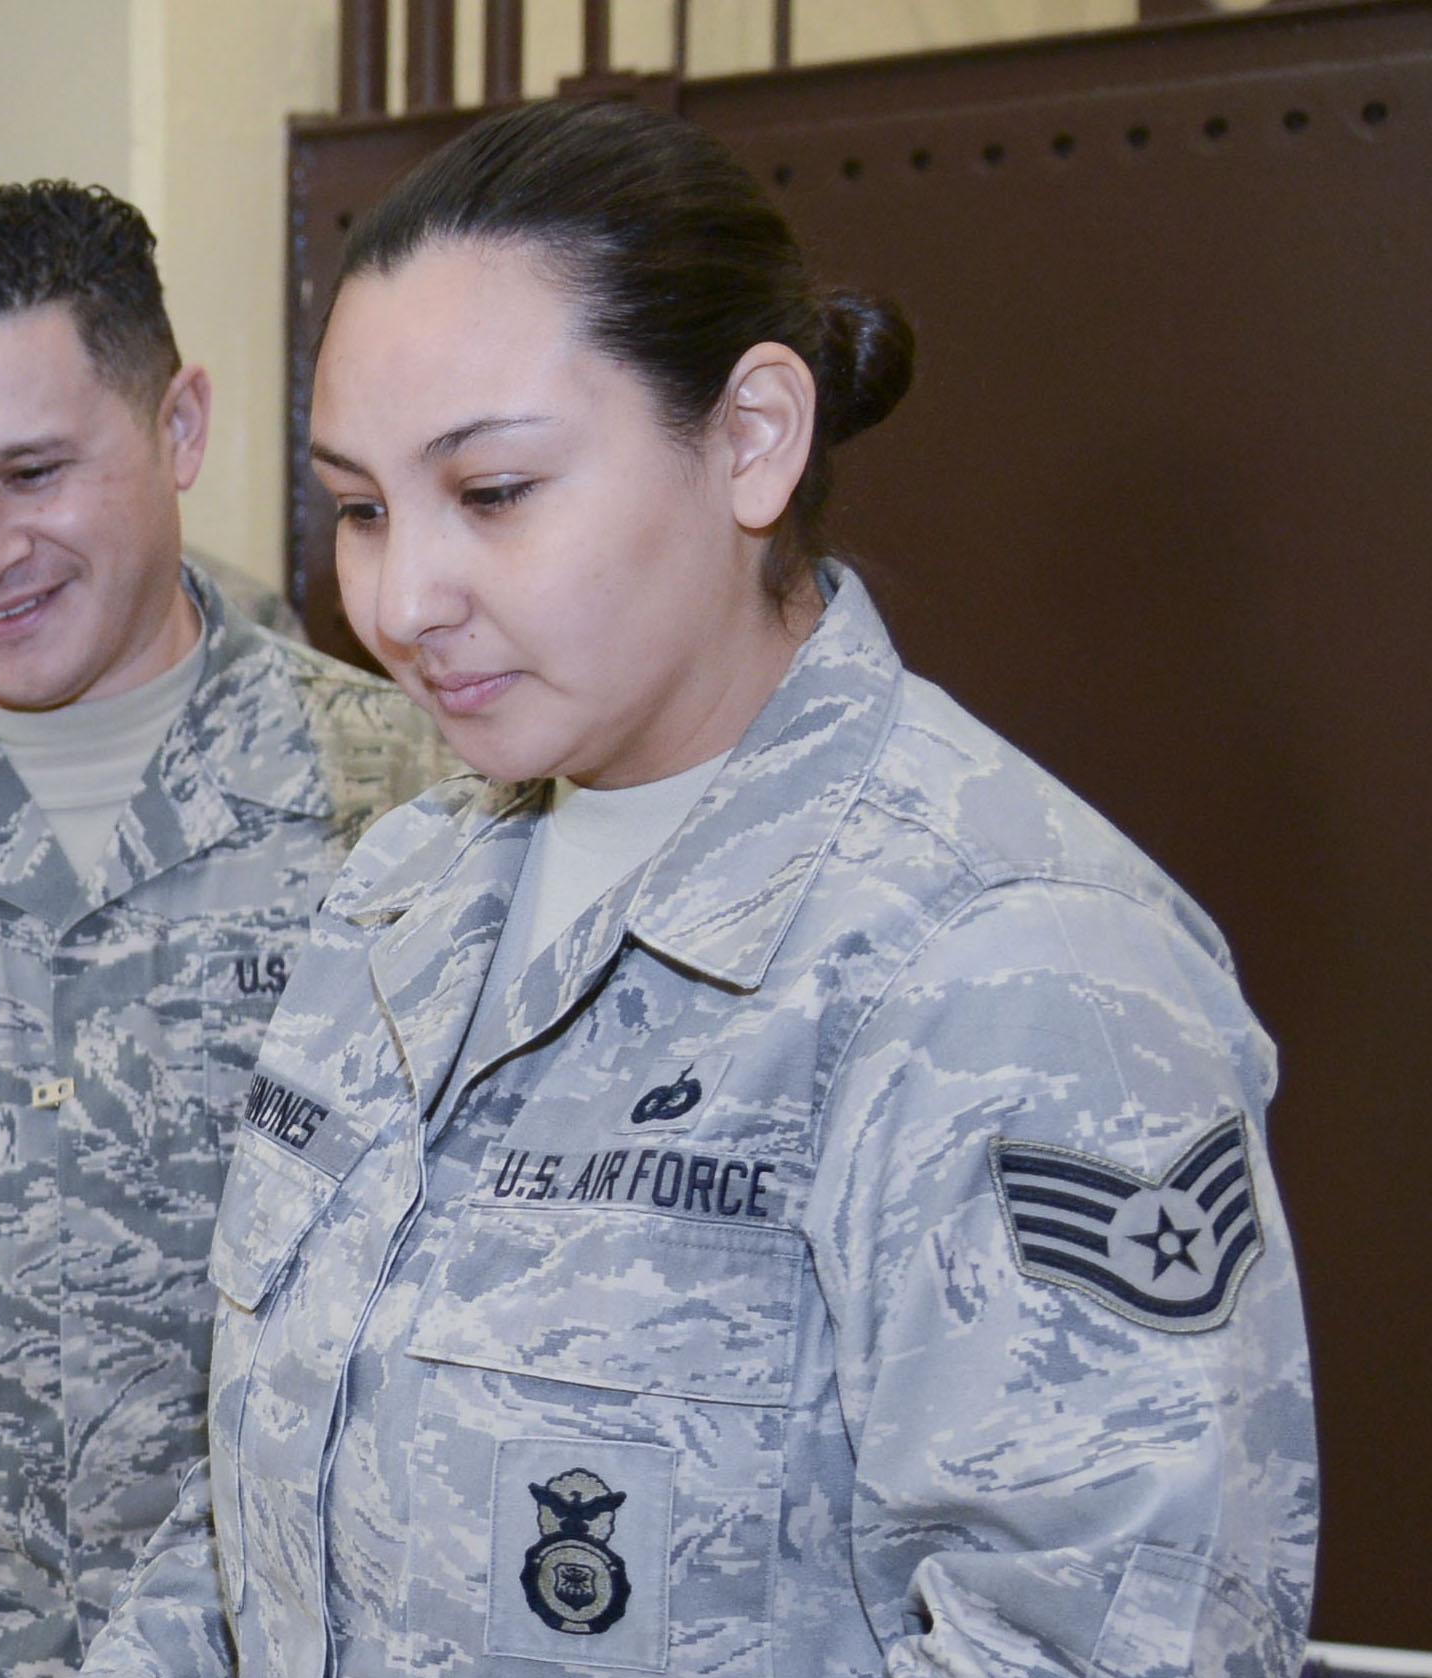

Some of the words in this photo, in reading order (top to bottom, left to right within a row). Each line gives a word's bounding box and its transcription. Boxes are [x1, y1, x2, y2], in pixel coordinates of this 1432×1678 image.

[493, 1150, 563, 1201] U.S.
[567, 1150, 630, 1201] AIR
[627, 1150, 776, 1218] FORCE
